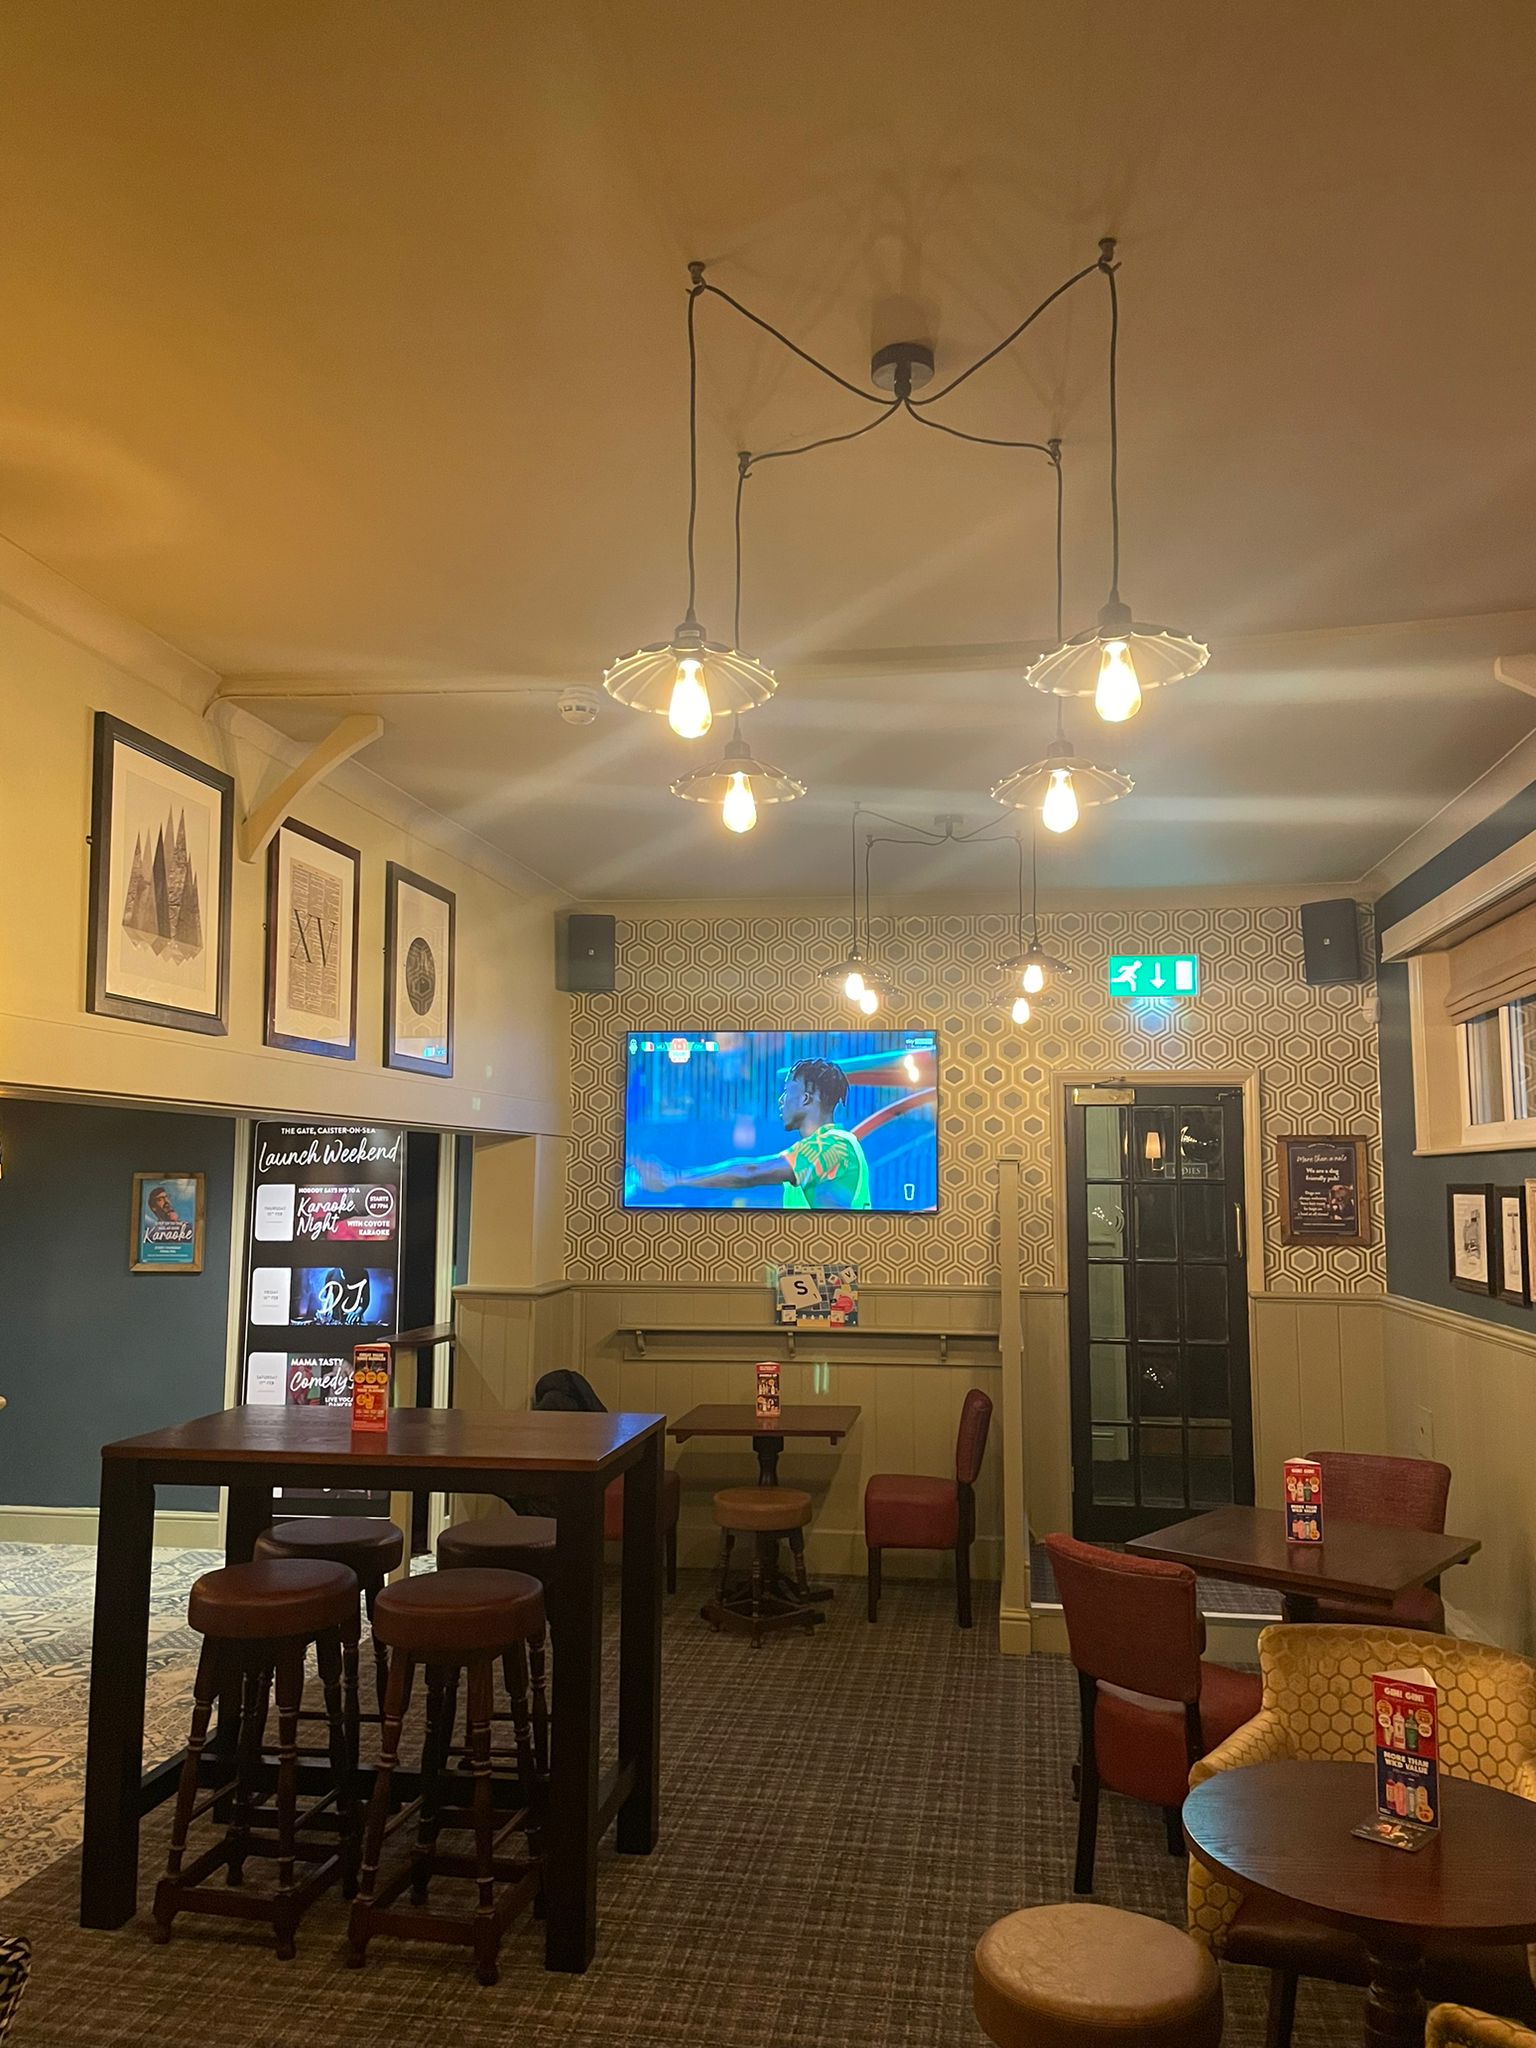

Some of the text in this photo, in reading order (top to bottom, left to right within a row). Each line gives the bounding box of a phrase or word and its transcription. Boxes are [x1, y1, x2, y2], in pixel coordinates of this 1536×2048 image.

[281, 1127, 376, 1136] THE GATE, CAISTER-ON-SEA
[258, 1135, 401, 1173] Launch Weekend
[1172, 1166, 1201, 1175] LDIES
[1305, 1175, 1326, 1183] friendly
[1329, 1168, 1339, 1176] dog
[297, 1193, 355, 1217] Karaoke
[143, 1222, 193, 1244] Karaoke
[296, 1212, 340, 1240] Night
[347, 1220, 390, 1228] WITH COYOTE
[318, 1278, 367, 1313] DJ
[793, 1280, 808, 1295] S
[291, 1357, 344, 1366] MAMA TASTY
[290, 1366, 348, 1395] Comedy
[1383, 1750, 1429, 1769] MORE THAN
[1384, 1757, 1404, 1769] WKD
[1405, 1762, 1429, 1775] VALUE
